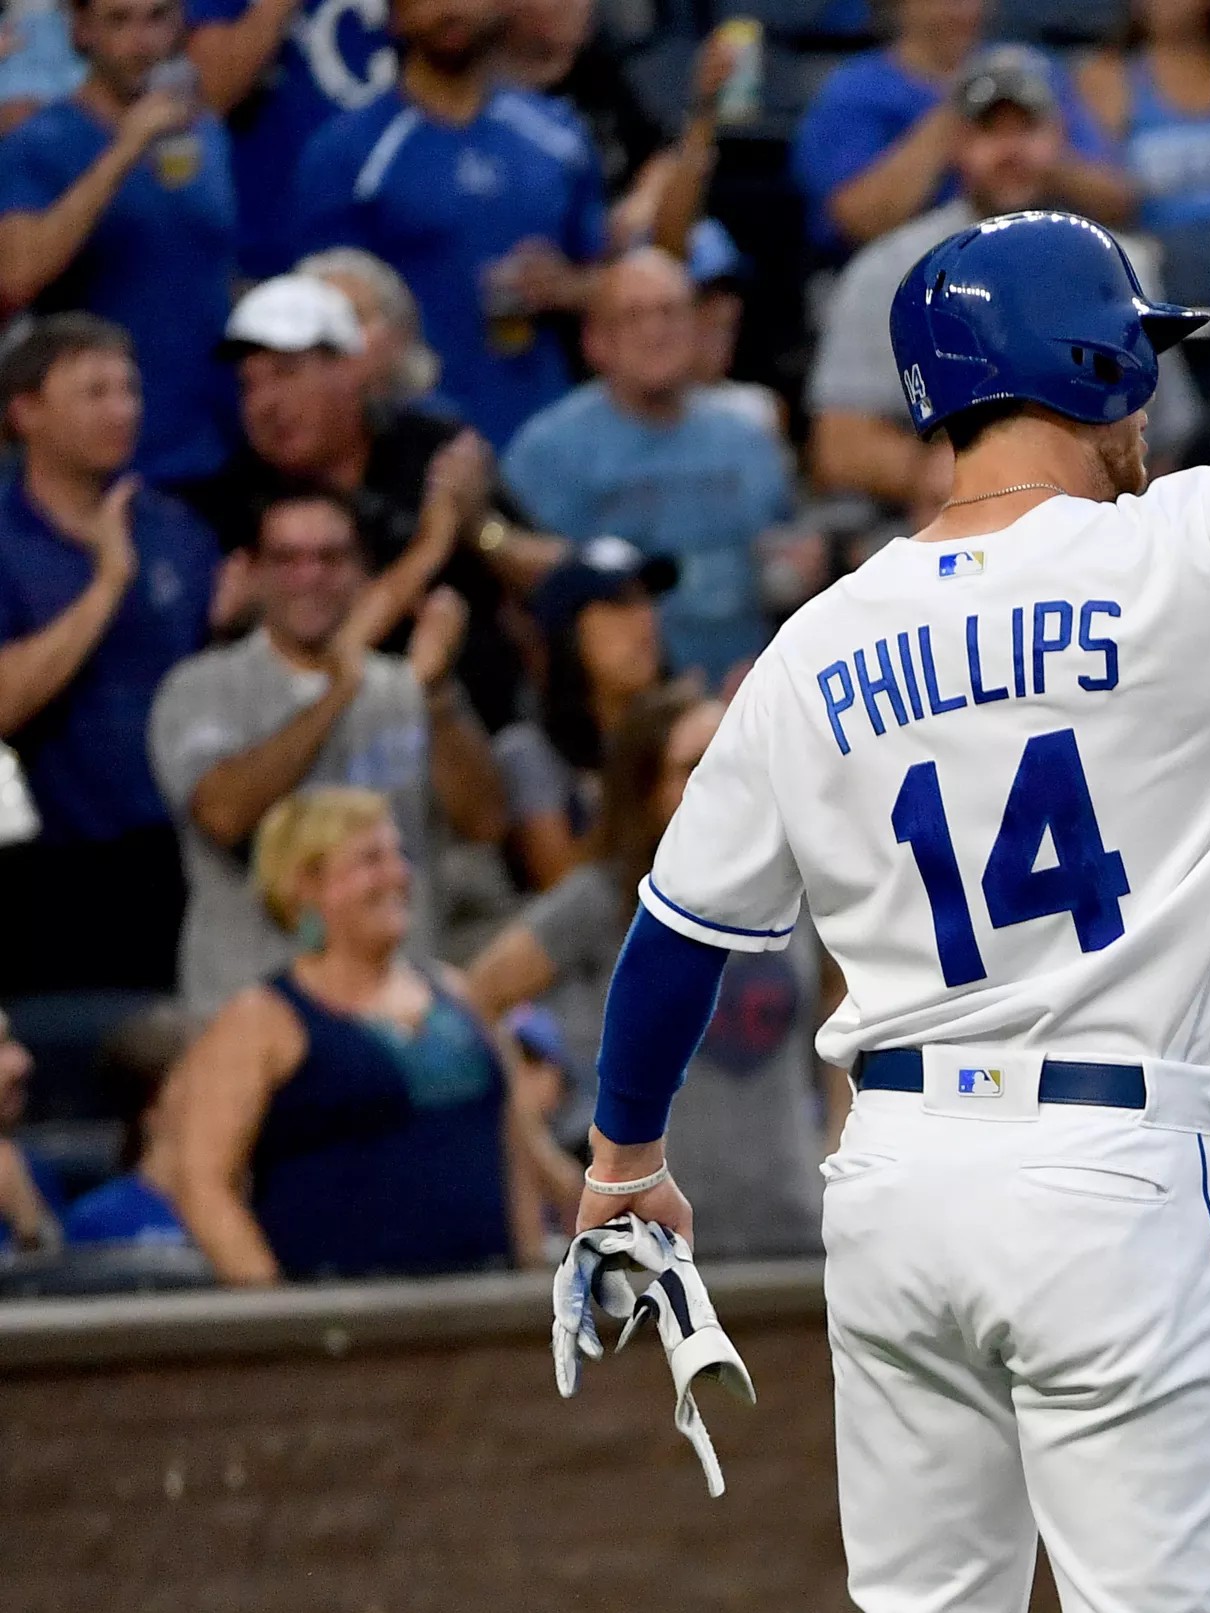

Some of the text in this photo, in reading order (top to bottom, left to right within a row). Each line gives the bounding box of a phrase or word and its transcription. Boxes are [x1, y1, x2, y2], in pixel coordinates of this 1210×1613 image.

[903, 363, 926, 405] 14
[817, 600, 1121, 756] PHILLIPS
[891, 728, 1130, 988] 14
